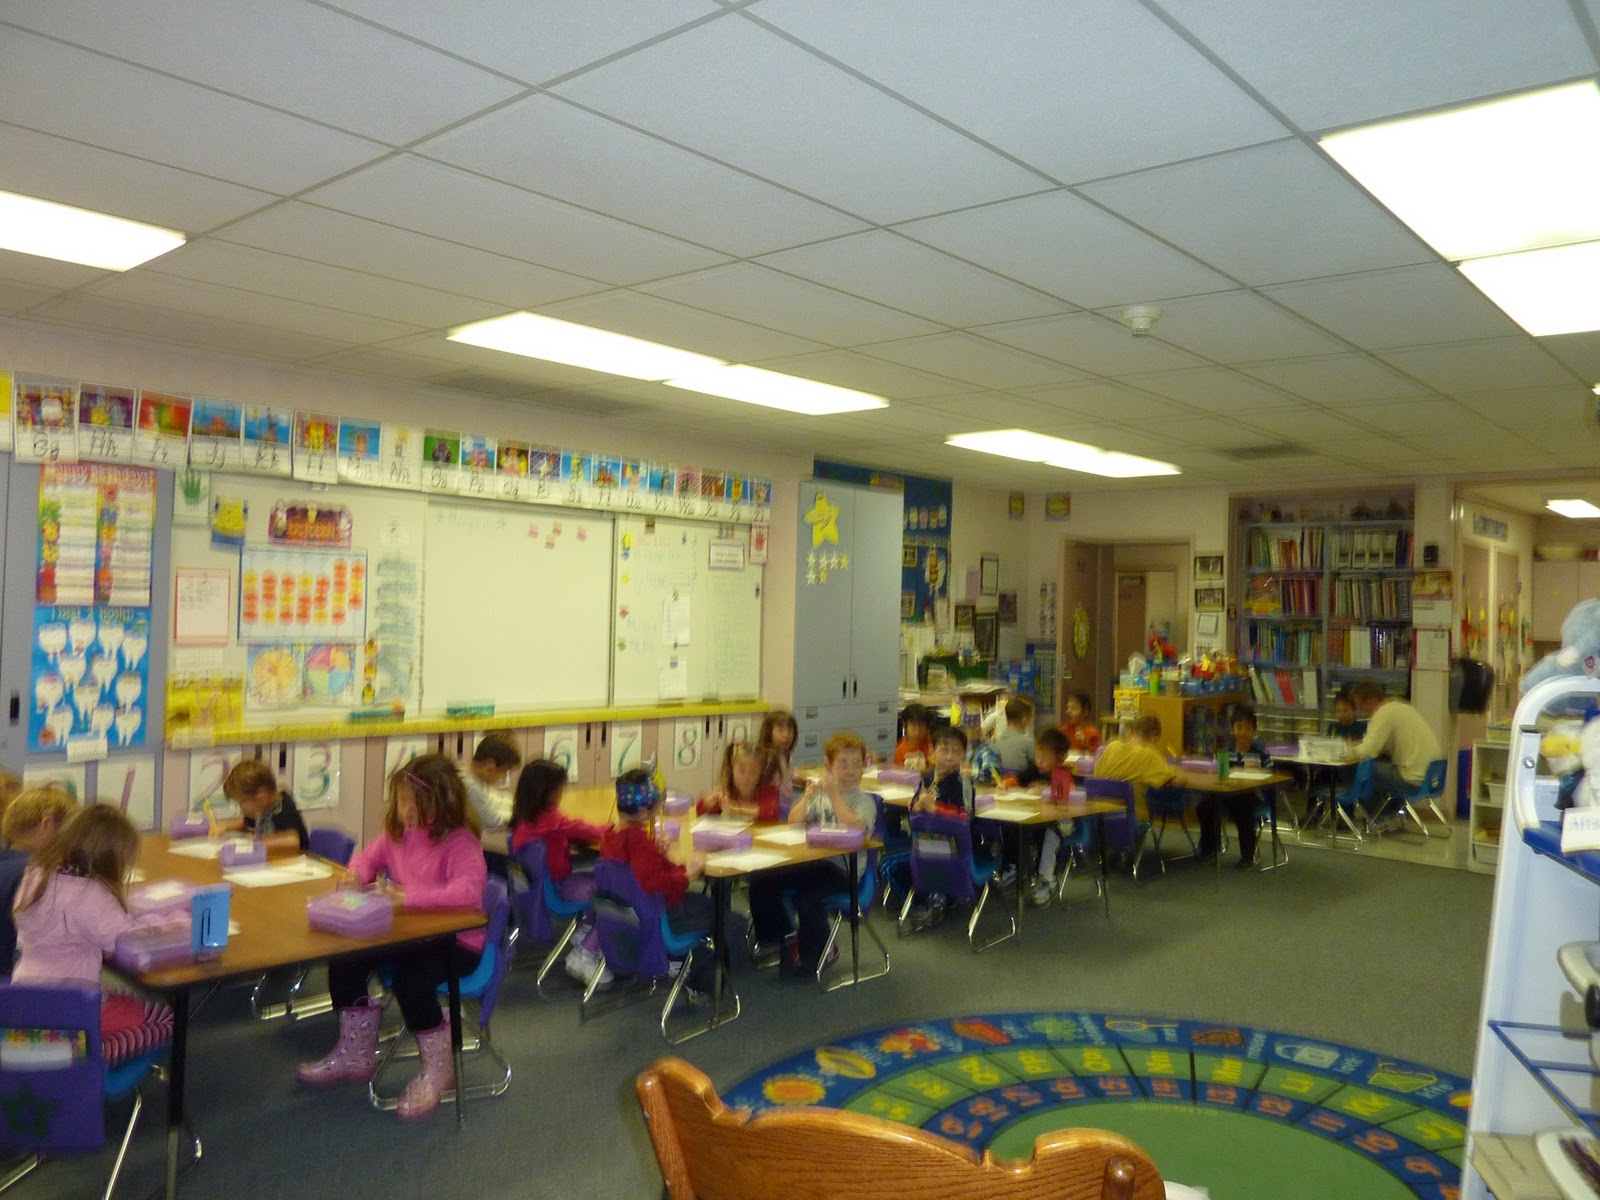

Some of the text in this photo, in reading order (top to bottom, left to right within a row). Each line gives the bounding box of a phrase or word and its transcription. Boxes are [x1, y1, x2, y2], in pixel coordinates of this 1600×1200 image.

[33, 432, 60, 461] Gg
[90, 430, 118, 458] Hh
[347, 457, 372, 481] Mm
[390, 461, 411, 484] Nn
[431, 466, 448, 489] Oo
[469, 470, 485, 494] Pp
[618, 730, 639, 774] 7
[677, 726, 698, 767] 8
[192, 752, 236, 813] 2
[301, 743, 332, 801] 3
[119, 766, 136, 817] 1
[1163, 1026, 1178, 1043] net
[1246, 1030, 1267, 1059] mouse
[1083, 1046, 1113, 1073] Oo
[1145, 1048, 1175, 1075] Nn
[1211, 1056, 1244, 1085] Mm
[1332, 1052, 1365, 1075] lock
[1001, 1085, 1042, 1109] 17
[1051, 1077, 1089, 1101] 16
[1098, 1075, 1134, 1097] 15
[1150, 1076, 1183, 1099] 14
[1205, 1083, 1238, 1105] 13
[1413, 1081, 1454, 1100] kite
[1256, 1094, 1294, 1117] 12
[1342, 1093, 1392, 1117] Kk
[1309, 1111, 1348, 1133] 11
[1352, 1129, 1400, 1155] 10
[1403, 1154, 1443, 1177] 9
